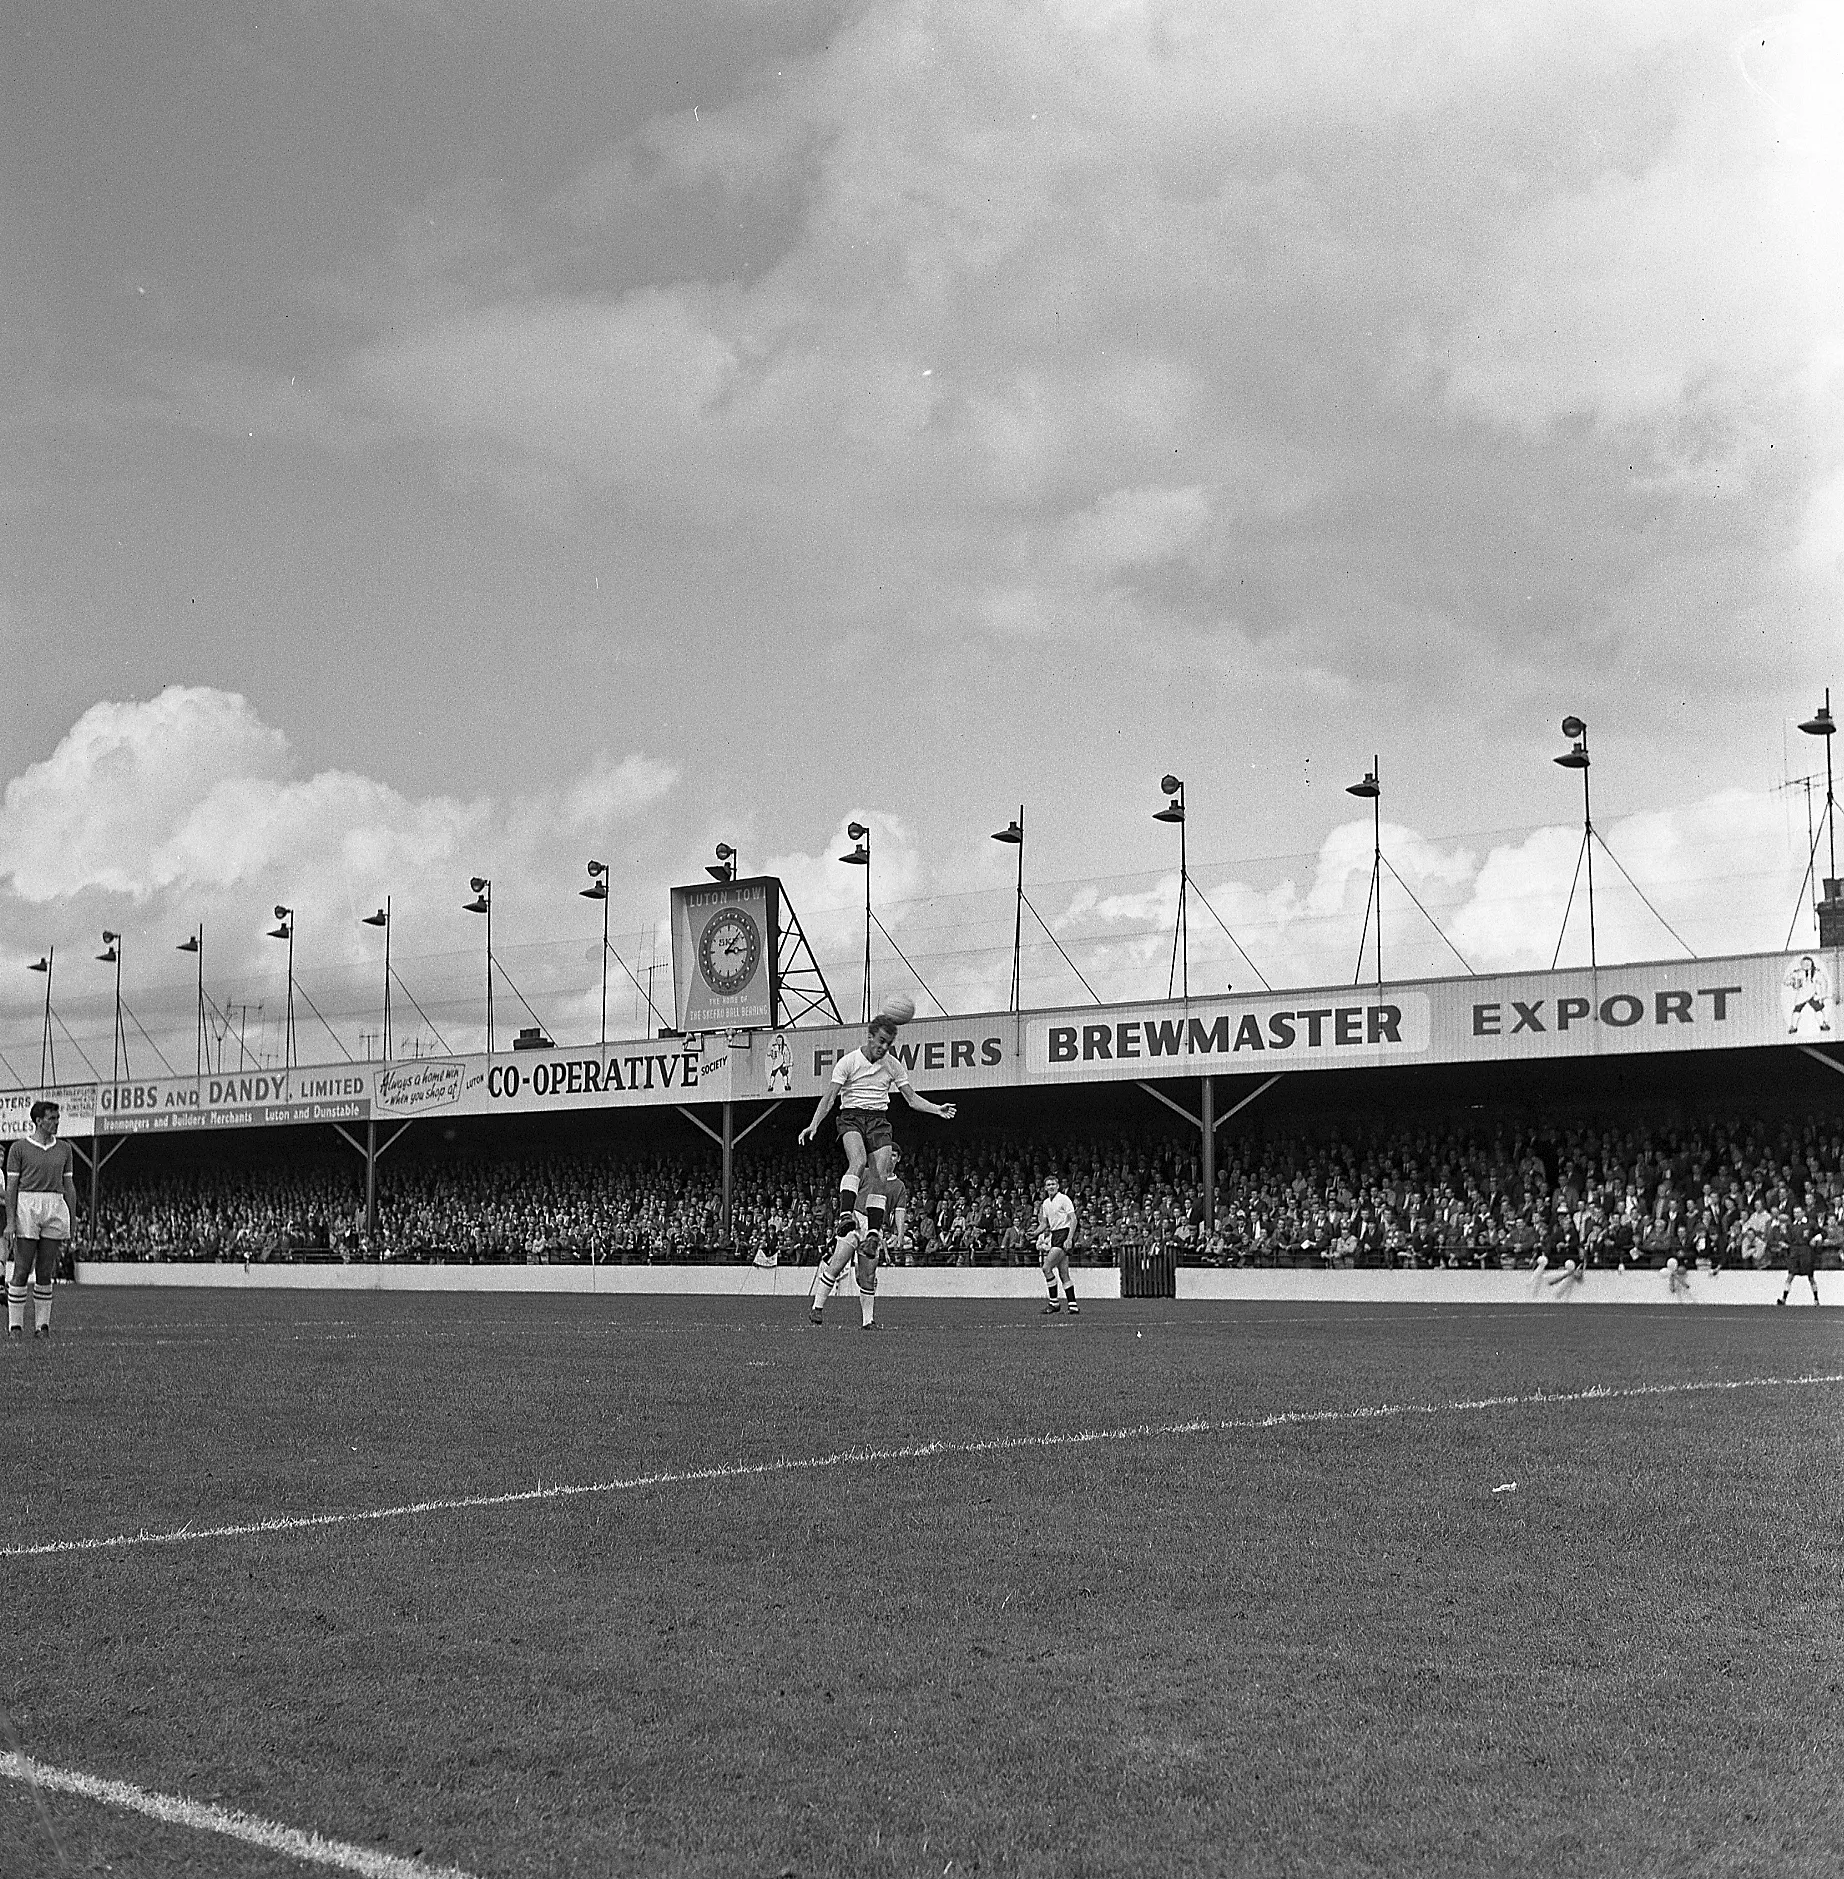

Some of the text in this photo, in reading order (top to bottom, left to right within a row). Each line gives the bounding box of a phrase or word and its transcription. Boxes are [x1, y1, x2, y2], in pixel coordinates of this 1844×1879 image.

[689, 886, 766, 908] LUTON TOW
[1472, 986, 1742, 1036] EXPORT
[1048, 1004, 1402, 1063] BREWMASTER
[813, 1037, 1002, 1077] FWERS
[380, 1071, 414, 1097] Always
[414, 1074, 421, 1086] a
[422, 1065, 445, 1084] home
[466, 1052, 728, 1098] LUTON CO-OPERATIVE SOCIETY
[101, 1086, 158, 1110] GIBBS
[165, 1090, 199, 1107] AND
[301, 1077, 364, 1098] LIMITED
[410, 1091, 425, 1105] you
[425, 1082, 446, 1101] shop
[447, 1080, 458, 1100] at
[103, 1116, 150, 1133] Ironmongers
[154, 1115, 169, 1128] and
[210, 1109, 254, 1125] Merchants
[265, 1107, 290, 1121] Luton
[293, 1107, 310, 1120] and
[313, 1102, 360, 1119] Dunstable
